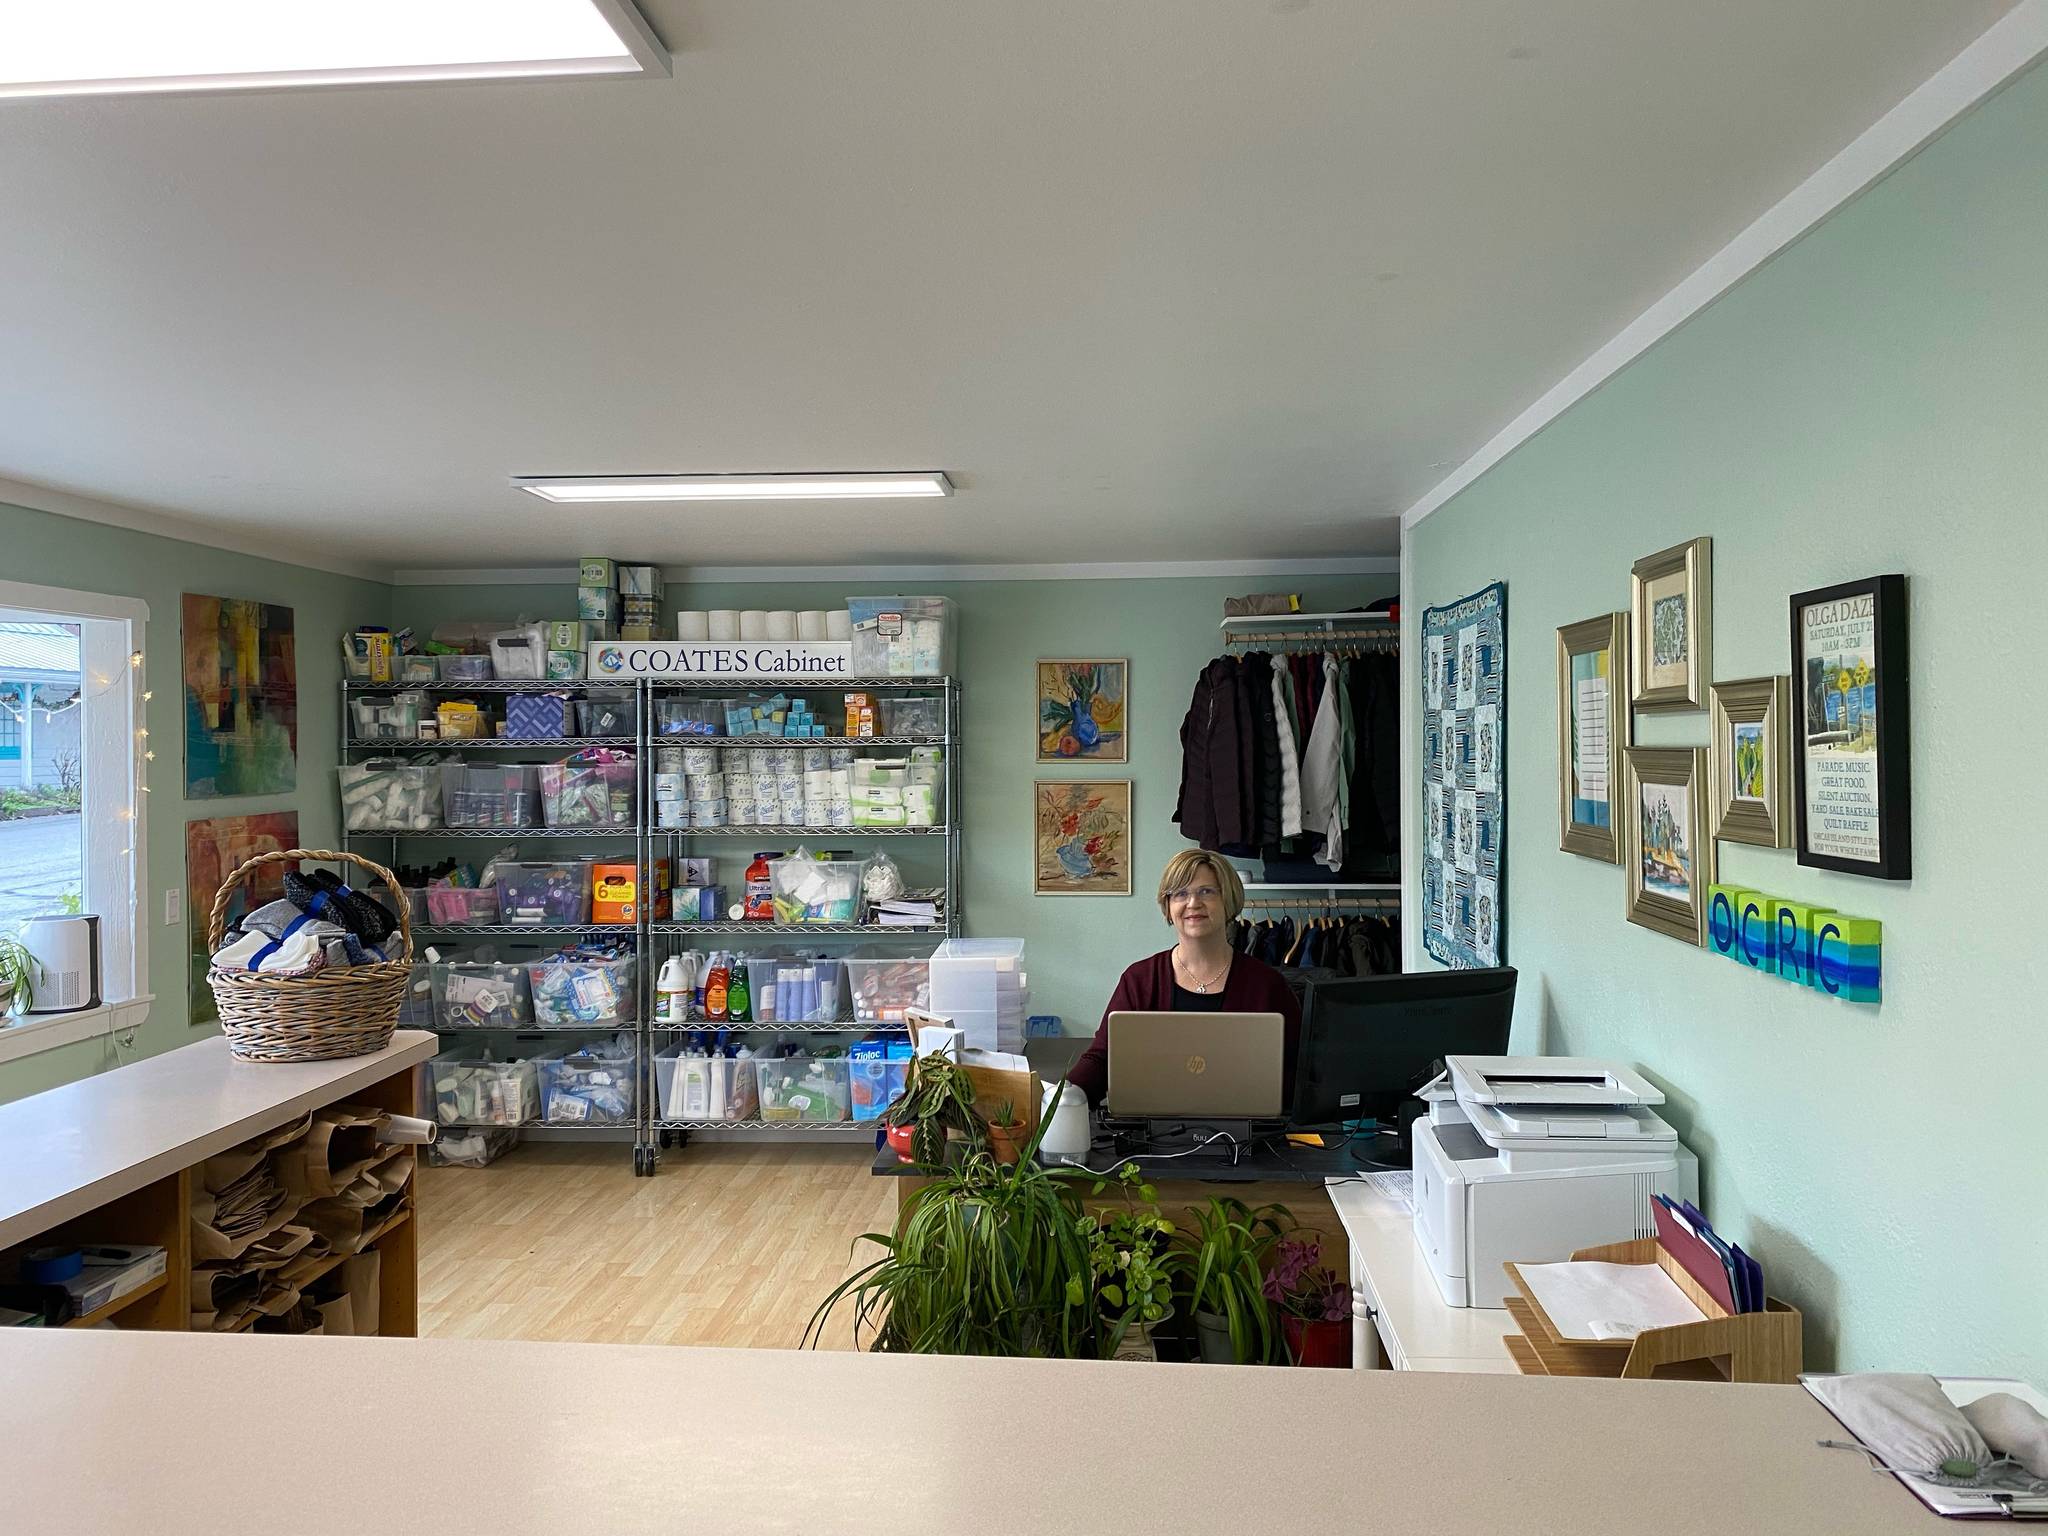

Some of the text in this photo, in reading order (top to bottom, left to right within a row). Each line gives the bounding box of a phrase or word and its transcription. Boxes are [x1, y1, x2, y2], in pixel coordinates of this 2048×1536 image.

[1807, 605, 1838, 627] OLGA
[1848, 621, 1864, 637] JULY
[629, 649, 845, 673] COATES Cabinet
[1821, 777, 1843, 787] GREAT
[1818, 791, 1839, 801] SILENT
[1811, 804, 1828, 814] YARD
[1845, 806, 1863, 817] BAKE
[1823, 819, 1869, 831] QUILT RAFFLE
[598, 885, 608, 899] 6
[1712, 892, 1841, 995] OCRC
[855, 1051, 880, 1063] Ziploc
